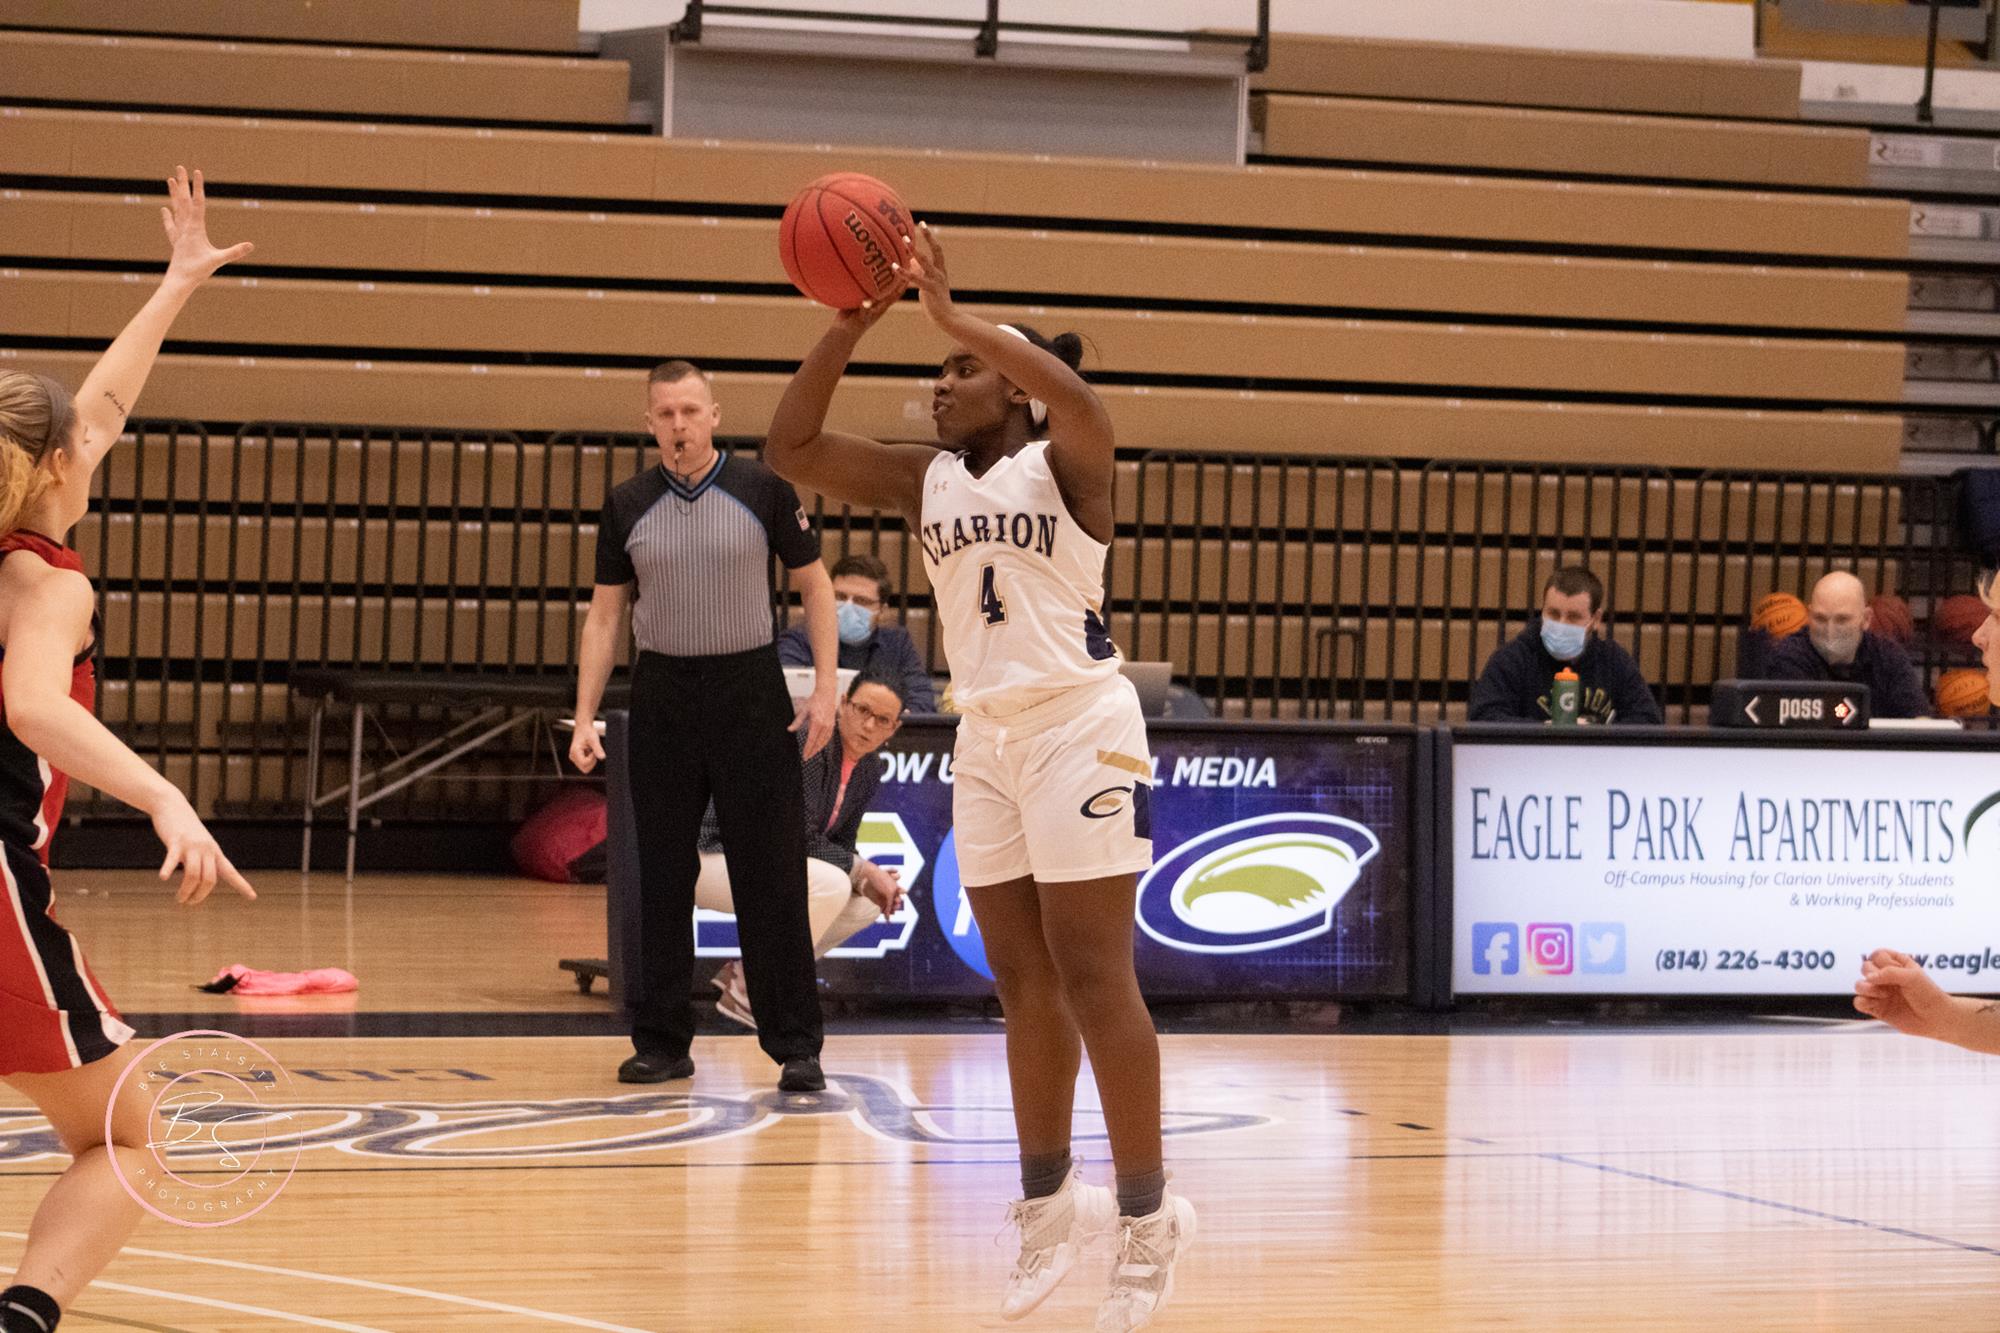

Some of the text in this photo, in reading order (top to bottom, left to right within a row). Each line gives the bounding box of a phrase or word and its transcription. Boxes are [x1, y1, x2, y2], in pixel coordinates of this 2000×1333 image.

[843, 211, 896, 293] Wilson
[978, 561, 1009, 630] 4
[1171, 757, 1277, 788] MEDIA
[1470, 787, 1955, 865] EAGLE PARK APARTMENTS
[1603, 870, 1955, 889] Off-Campus Housing for Clarion University Students
[1789, 893, 1955, 910] & Working Professionals
[1655, 949, 1708, 971] (814)
[1715, 949, 1836, 970] 226-4300
